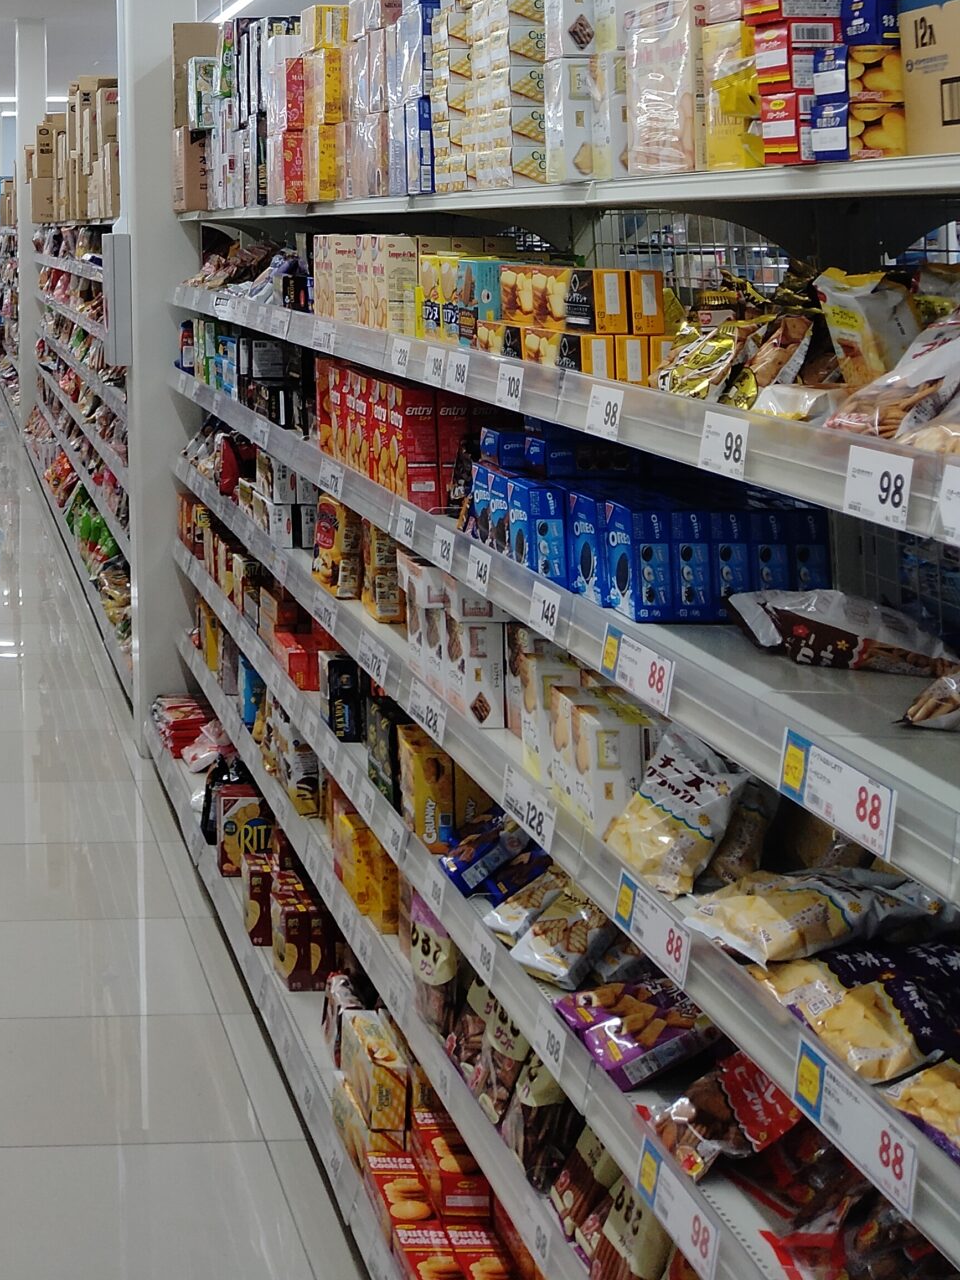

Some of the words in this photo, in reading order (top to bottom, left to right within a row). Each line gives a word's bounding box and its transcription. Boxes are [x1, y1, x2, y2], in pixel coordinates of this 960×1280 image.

[453, 363, 466, 383] 198
[507, 375, 521, 400] 108
[603, 400, 619, 428] 98
[724, 431, 743, 464] 98
[878, 470, 905, 509] 98
[490, 499, 508, 513] OREO
[510, 508, 528, 524] OREO
[573, 520, 595, 536] OREO
[609, 530, 631, 547] OREO
[475, 559, 488, 585] 148
[542, 599, 557, 627] 148
[647, 660, 666, 694] 88
[424, 705, 439, 733] 128
[658, 753, 716, 795] チーズ
[423, 799, 437, 844] CRUNKY
[525, 800, 545, 837] 128
[855, 785, 882, 830] 88
[666, 927, 683, 963] 88
[545, 1029, 562, 1064] 198
[368, 1156, 414, 1166] Butter
[370, 1161, 417, 1171] Cookies
[878, 1129, 906, 1181] 88
[396, 1228, 446, 1239] Butter
[400, 1235, 449, 1246] Cookies
[690, 1214, 710, 1259] 98
